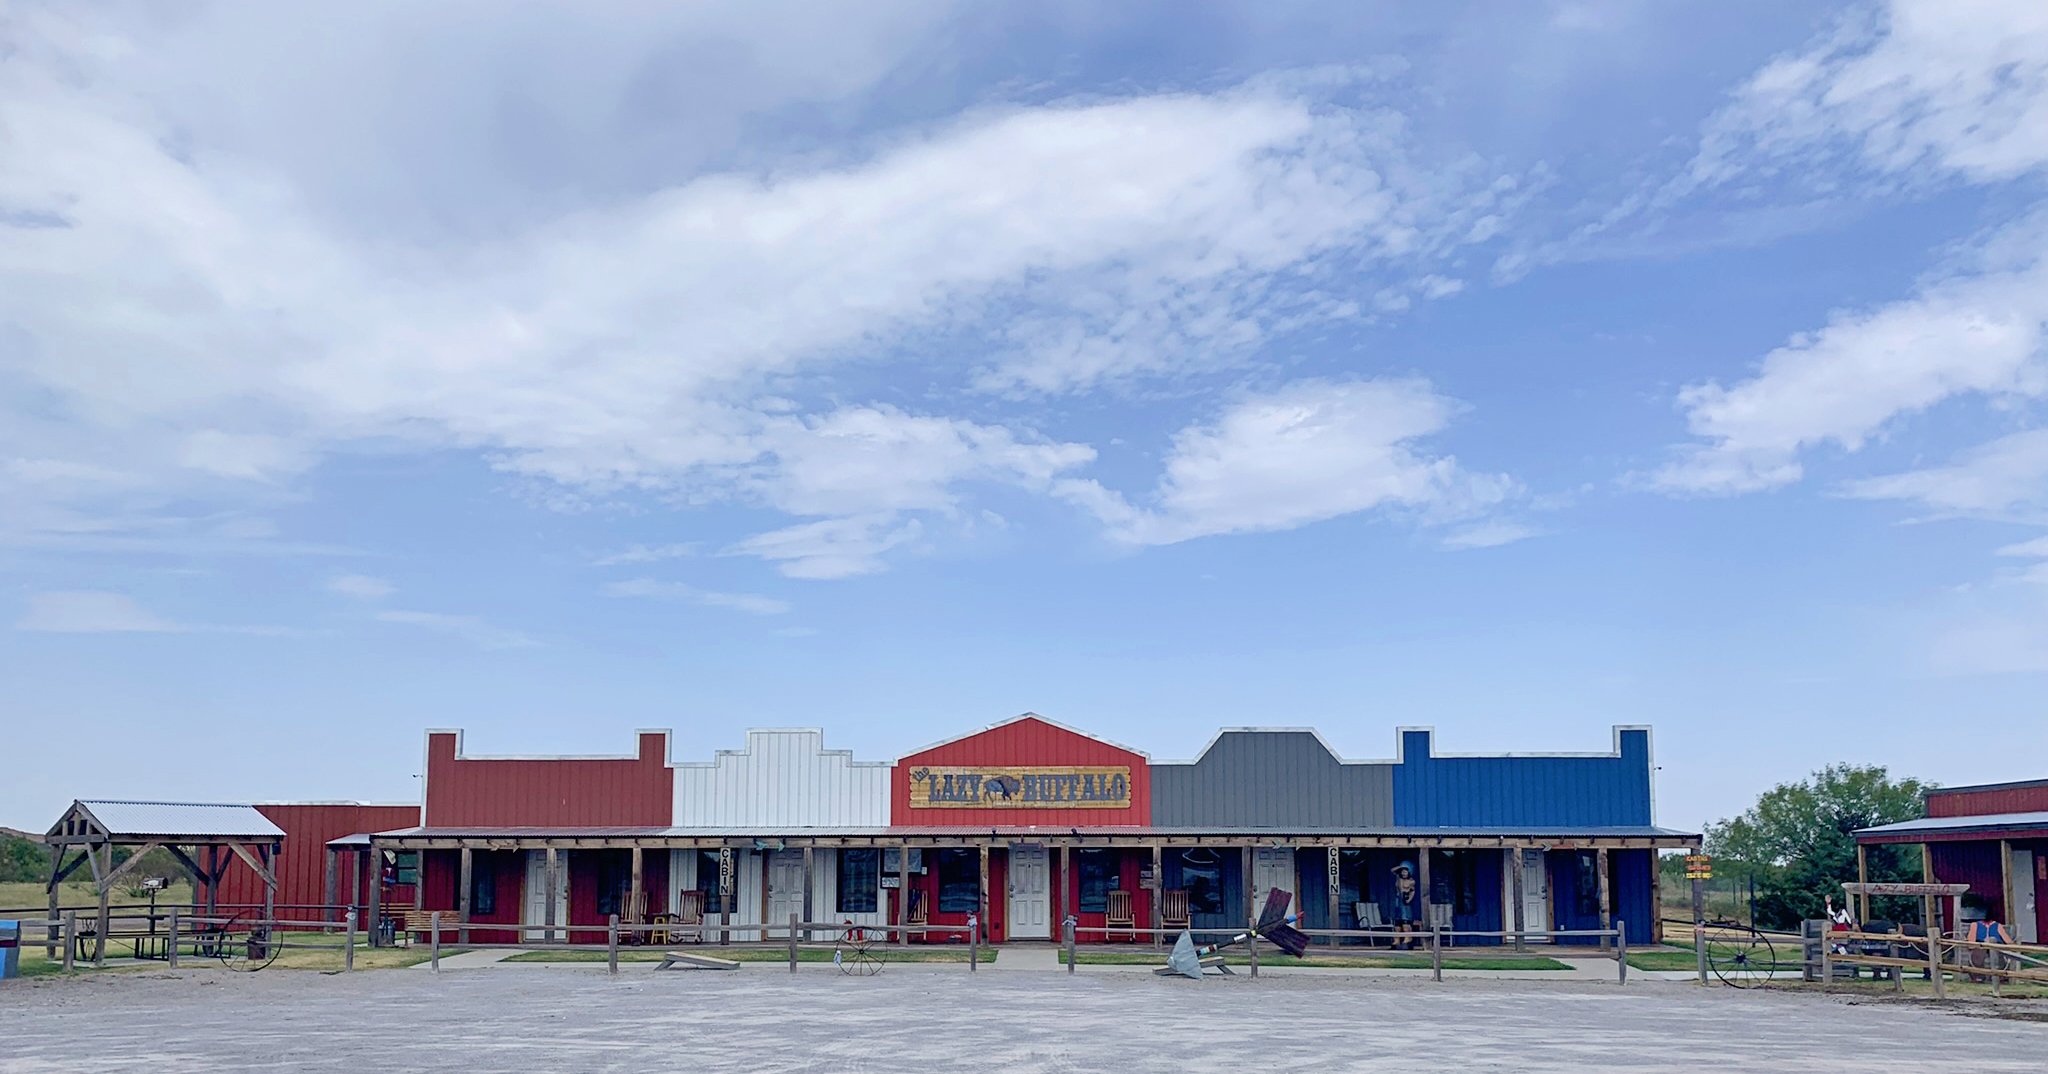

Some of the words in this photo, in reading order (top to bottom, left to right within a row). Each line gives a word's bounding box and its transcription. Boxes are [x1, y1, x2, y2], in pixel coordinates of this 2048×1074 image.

[912, 767, 930, 782] the
[928, 774, 983, 801] LAZY
[1022, 774, 1126, 801] BUFFALO
[721, 849, 729, 894] CABIN
[1330, 848, 1339, 894] CABIN
